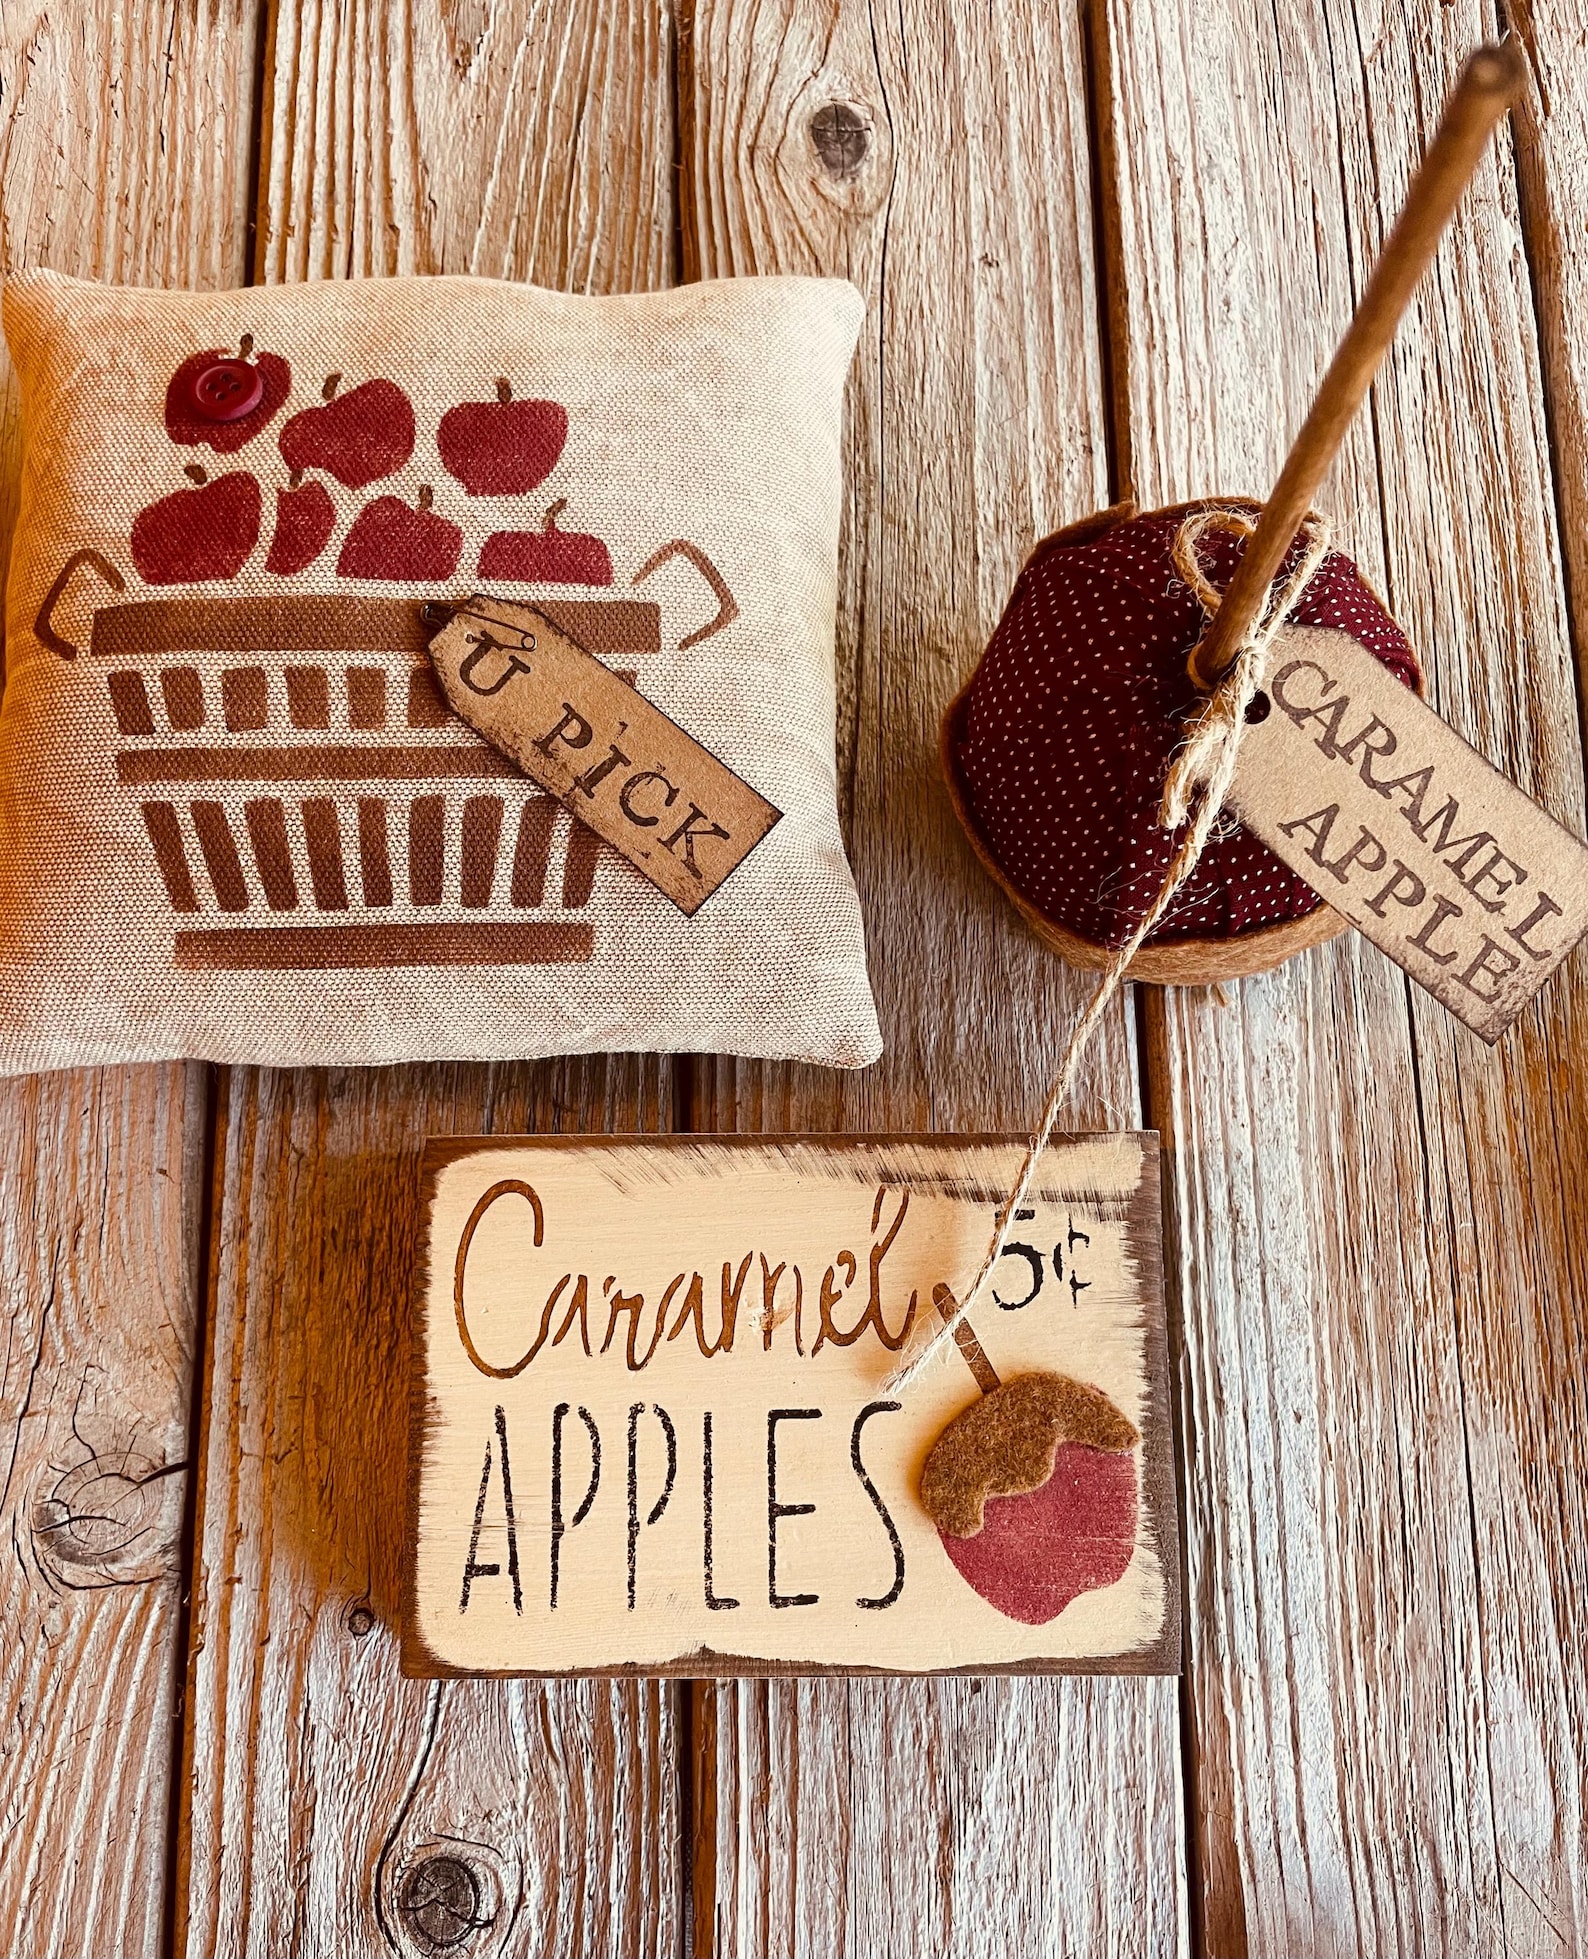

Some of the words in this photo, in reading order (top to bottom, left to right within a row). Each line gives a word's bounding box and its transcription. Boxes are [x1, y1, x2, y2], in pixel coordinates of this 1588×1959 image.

[460, 631, 531, 697] U
[534, 703, 730, 880] PICK
[1271, 660, 1563, 962] CARAMEL
[1277, 803, 1521, 1004] APPLE
[453, 1179, 918, 1379] Caramel
[459, 1401, 903, 1616] APPLES
